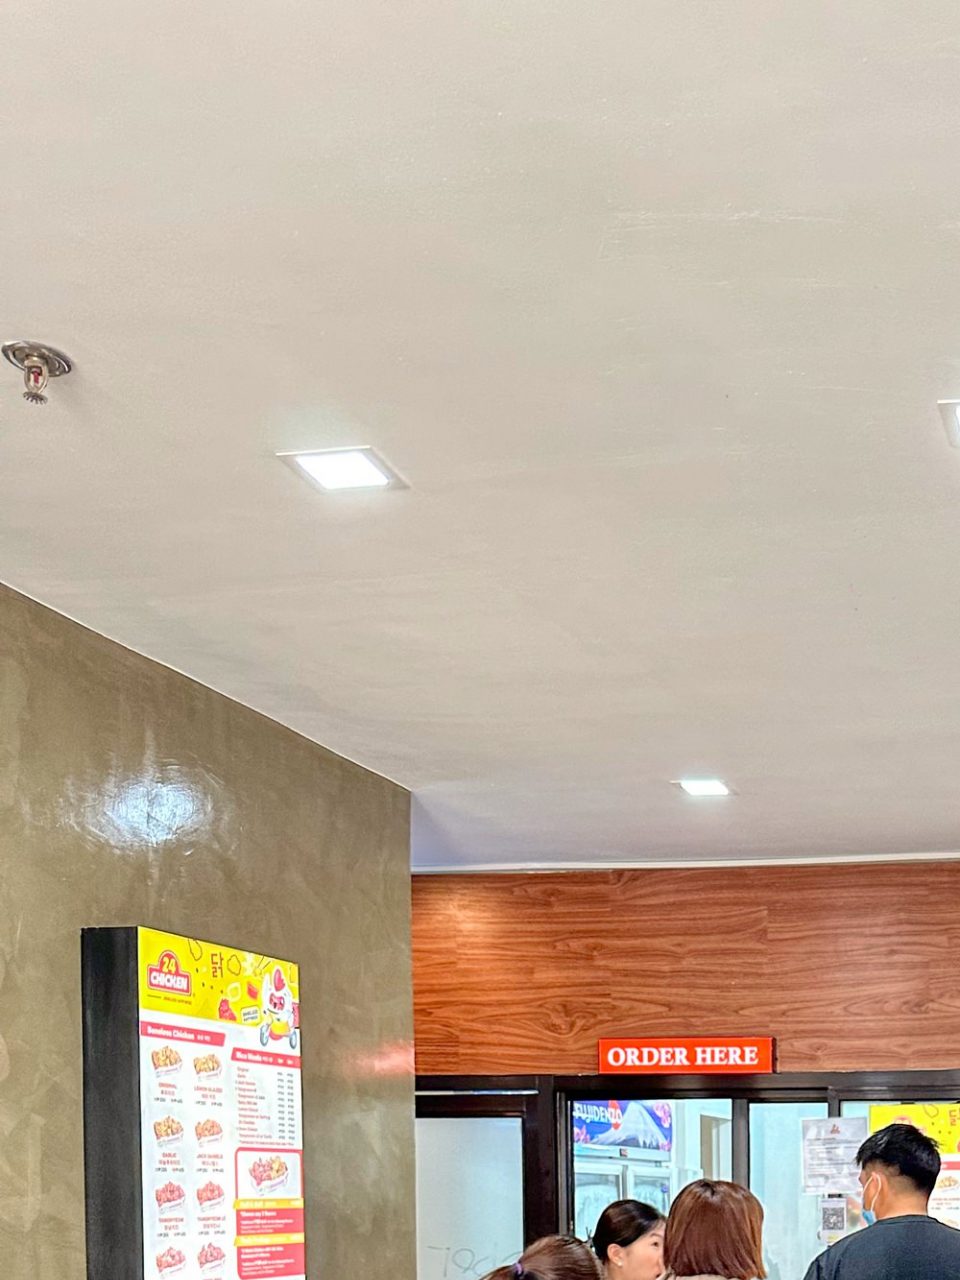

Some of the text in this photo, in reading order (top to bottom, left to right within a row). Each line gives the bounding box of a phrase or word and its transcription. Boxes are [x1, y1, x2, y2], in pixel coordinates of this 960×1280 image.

[162, 956, 177, 974] 24
[150, 971, 188, 990] CHICKEN
[607, 1046, 759, 1066] ORDER HERE
